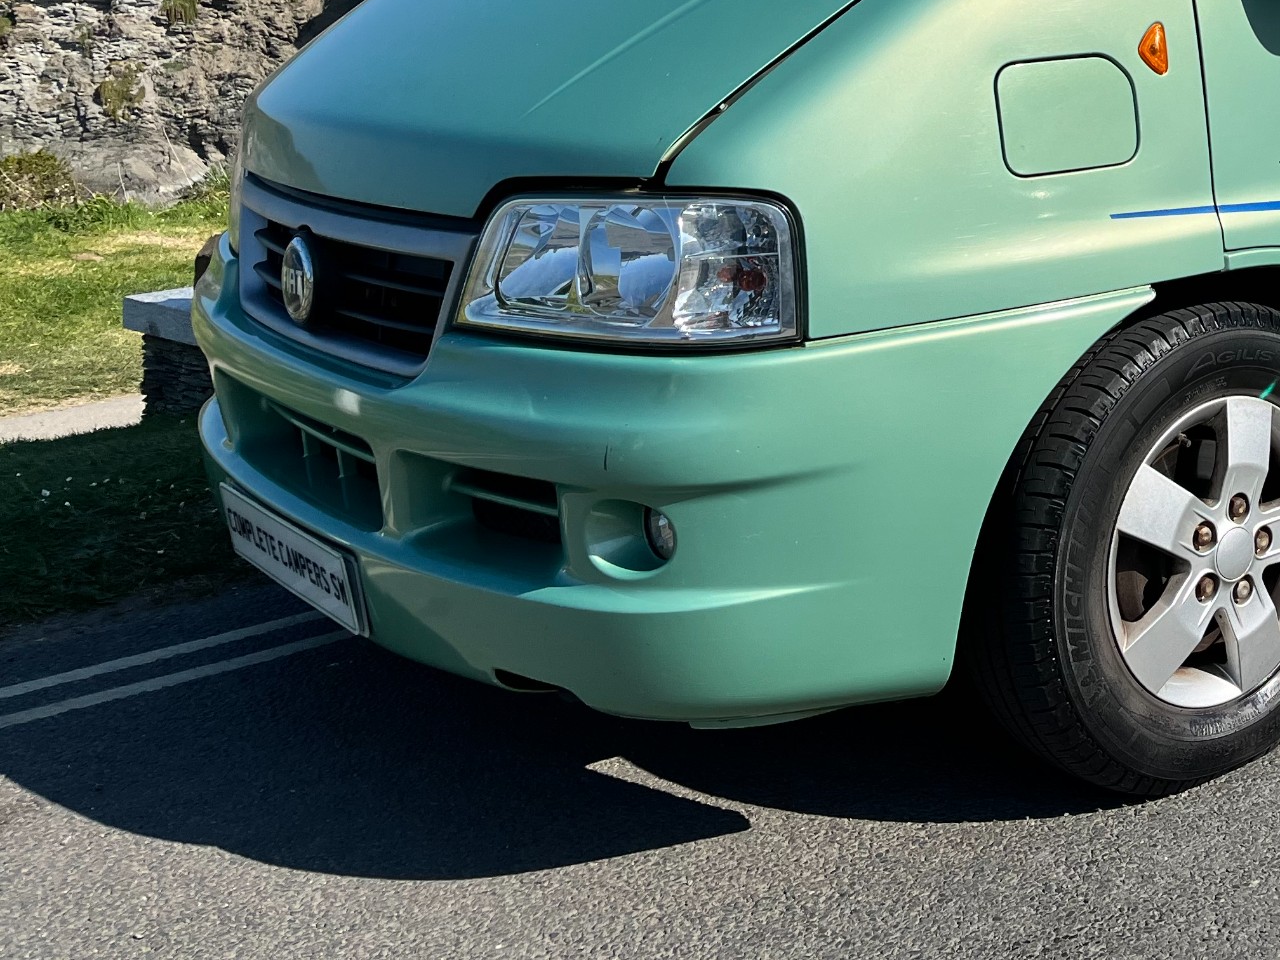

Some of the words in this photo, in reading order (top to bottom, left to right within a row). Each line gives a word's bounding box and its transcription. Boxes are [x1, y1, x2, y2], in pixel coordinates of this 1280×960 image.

[1184, 348, 1276, 382] AGILIS
[227, 508, 280, 562] COMPLETE
[277, 540, 331, 595] CAMPERS
